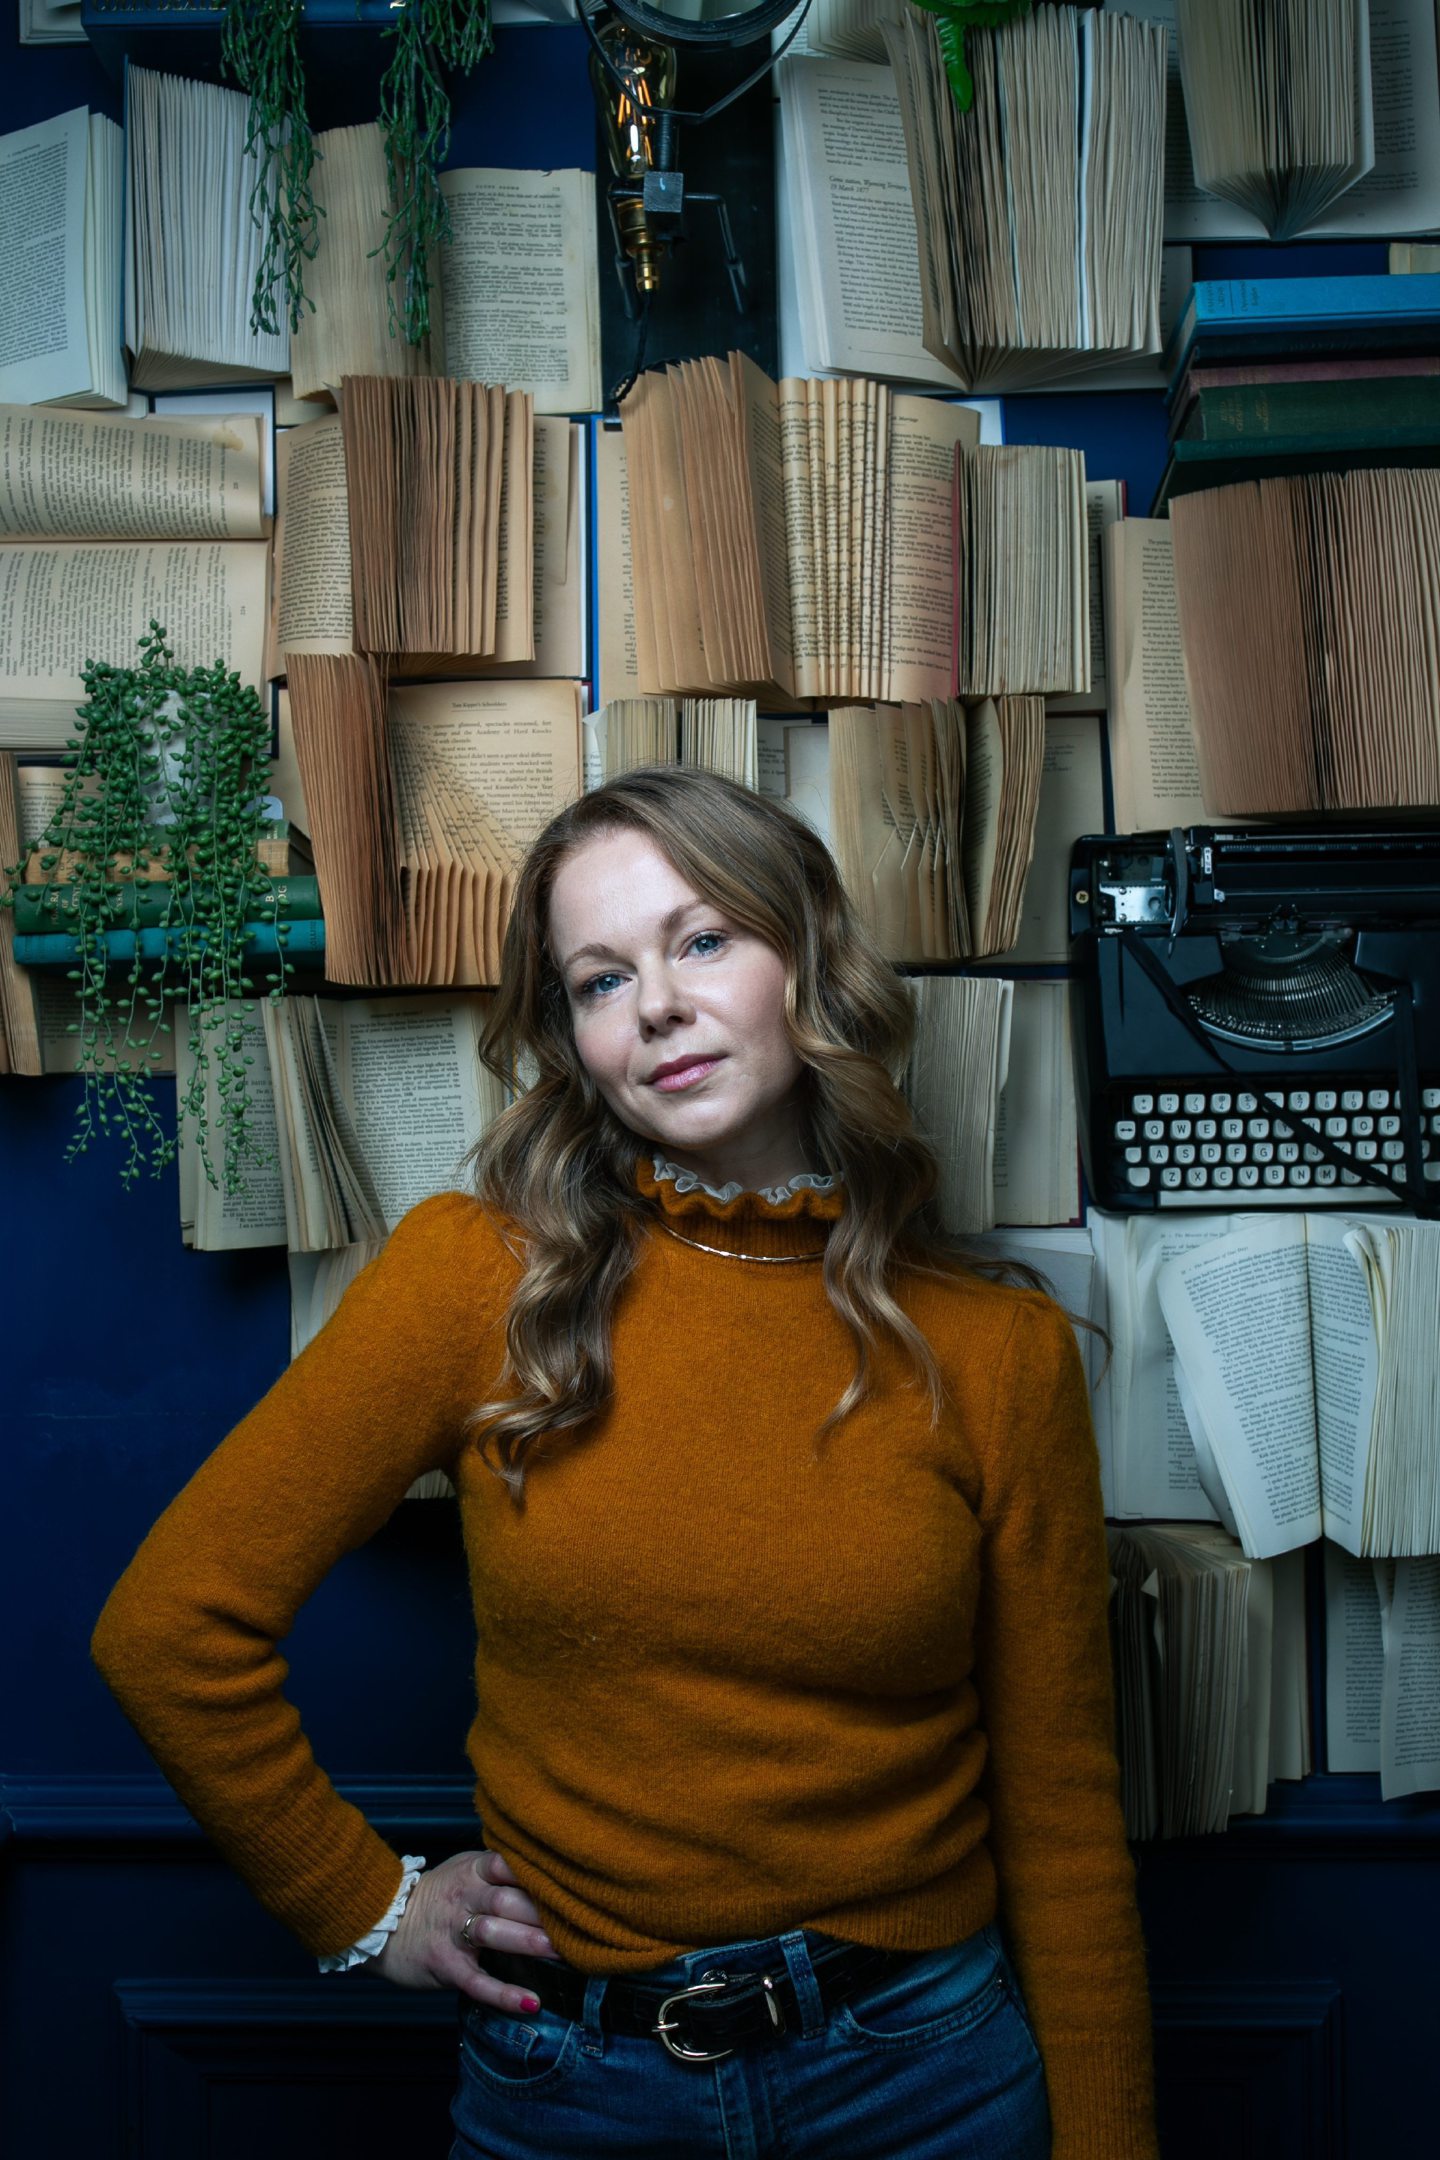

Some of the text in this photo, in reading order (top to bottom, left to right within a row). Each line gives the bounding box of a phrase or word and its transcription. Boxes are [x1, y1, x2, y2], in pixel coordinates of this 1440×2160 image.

[1150, 1125, 1158, 1135] Q
[1176, 1124, 1186, 1134] W
[1203, 1124, 1210, 1134] E
[1230, 1123, 1237, 1133] R
[1256, 1123, 1263, 1132] T
[1360, 1121, 1368, 1131] O
[1386, 1121, 1394, 1131] P
[1156, 1149, 1163, 1159] A
[1182, 1148, 1189, 1159] S
[1208, 1148, 1215, 1158] D
[1233, 1148, 1240, 1157] F
[1259, 1147, 1267, 1157] G
[1286, 1147, 1293, 1157] H
[1364, 1147, 1371, 1156] L
[1168, 1169, 1331, 1182] Z X C V B N M
